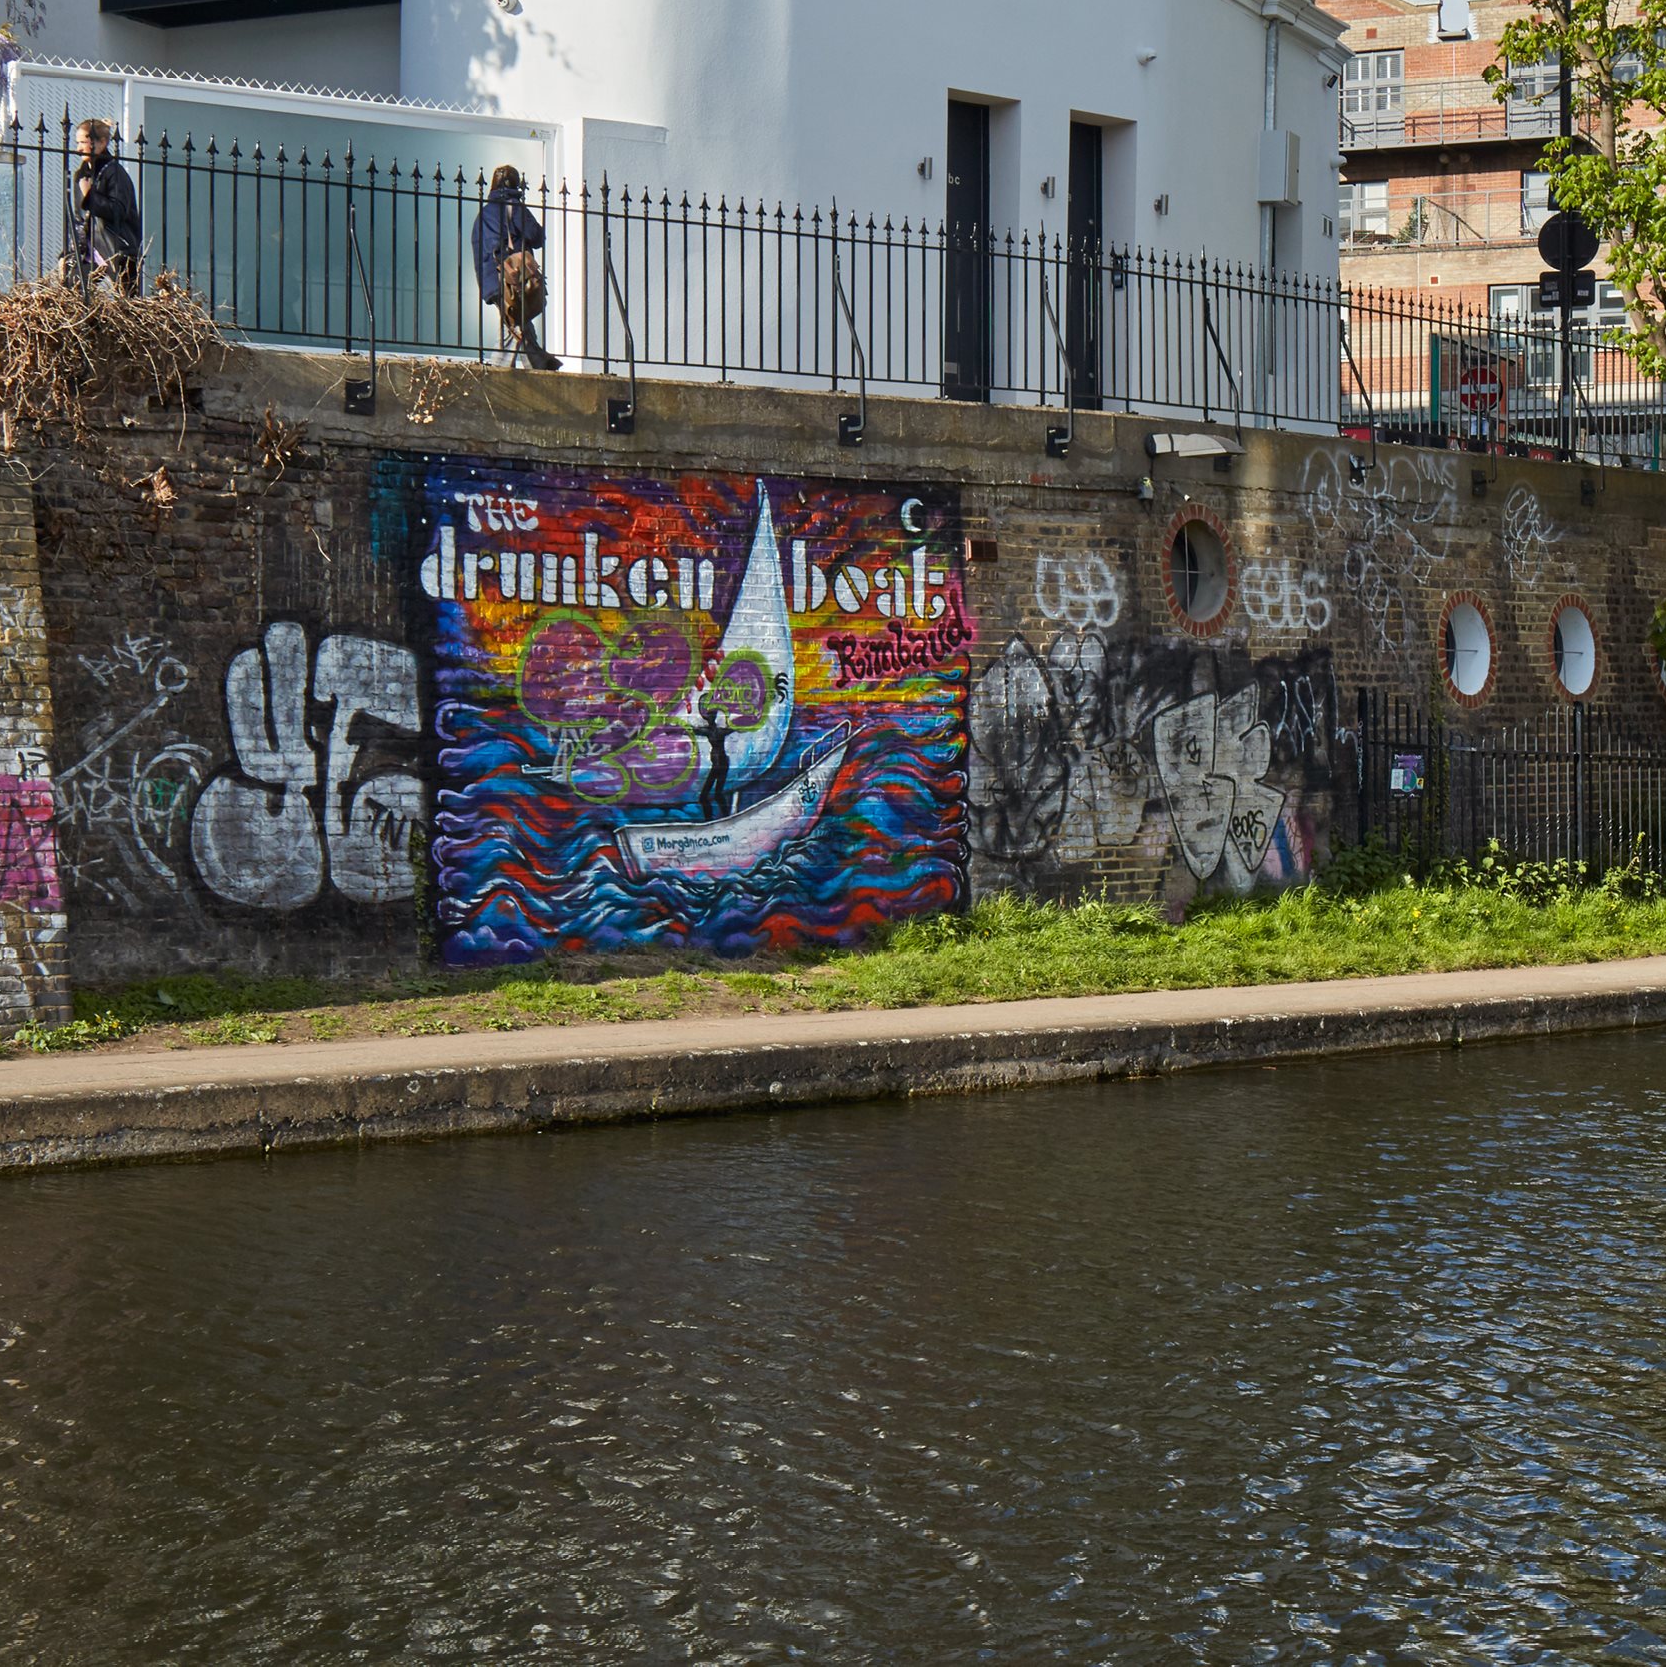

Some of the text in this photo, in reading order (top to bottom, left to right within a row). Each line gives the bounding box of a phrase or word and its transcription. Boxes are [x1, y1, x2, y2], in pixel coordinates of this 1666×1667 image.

[454, 491, 539, 532] THE
[419, 525, 715, 611] drunken
[791, 538, 947, 620] boat
[826, 588, 973, 688] Rimbaud
